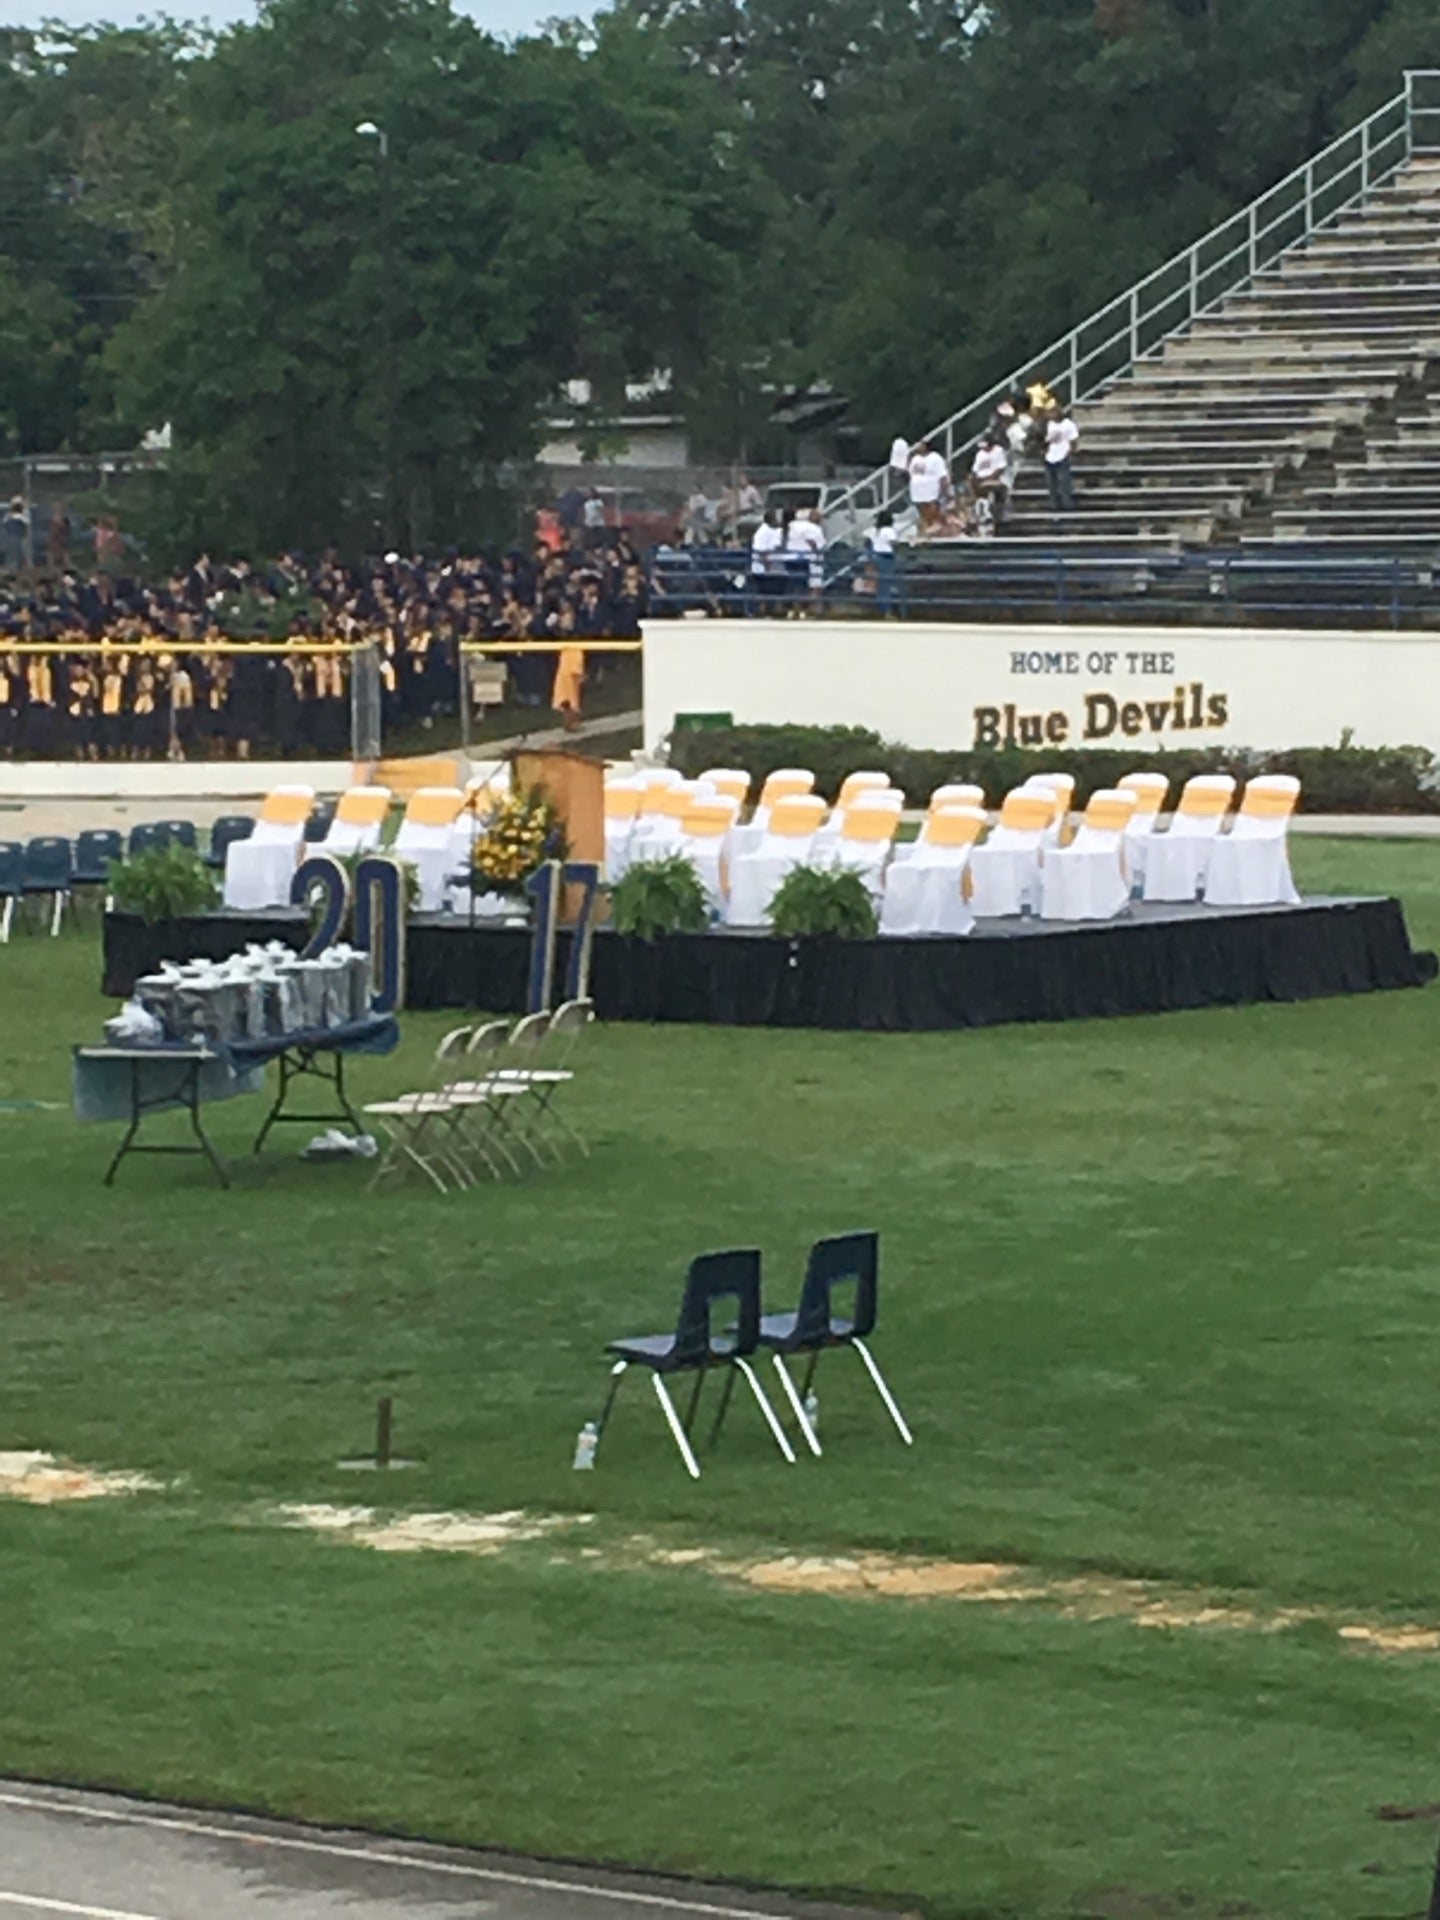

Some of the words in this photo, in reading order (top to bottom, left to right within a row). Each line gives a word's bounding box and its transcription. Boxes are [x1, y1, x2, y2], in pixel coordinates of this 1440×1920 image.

[1010, 651, 1079, 674] HOME
[1086, 651, 1118, 674] OF
[1126, 652, 1175, 674] THE
[973, 703, 1069, 749] Blue
[1083, 682, 1228, 740] Devils
